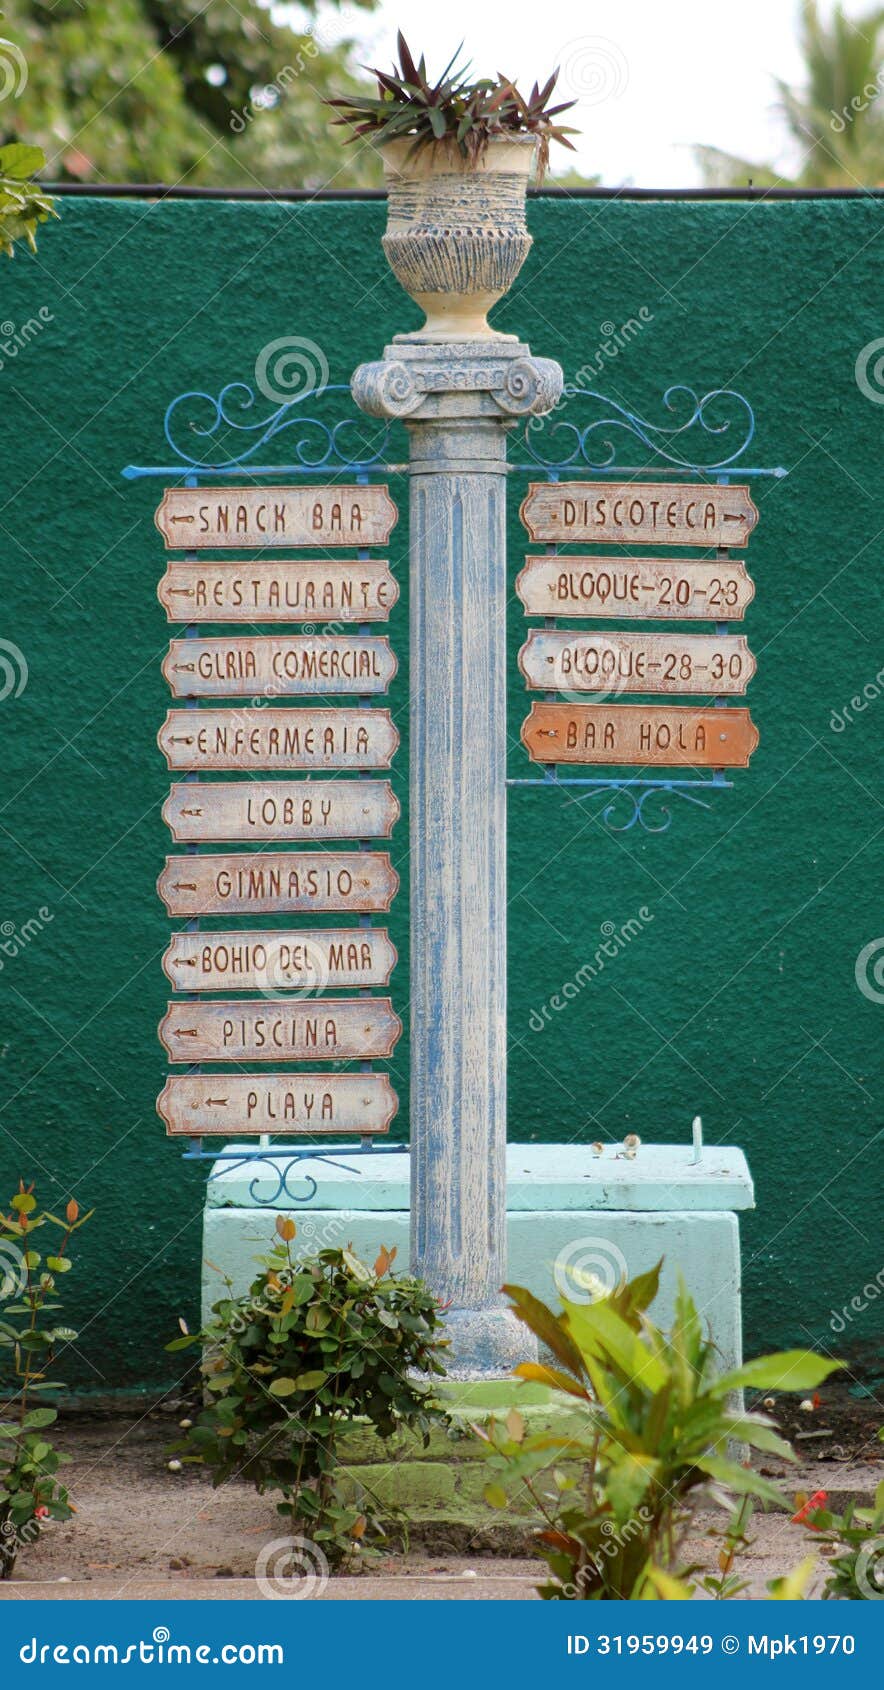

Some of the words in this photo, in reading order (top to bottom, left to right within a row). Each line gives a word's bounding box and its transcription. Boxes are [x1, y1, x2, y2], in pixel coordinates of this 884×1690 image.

[199, 505, 286, 533] SNACK
[563, 500, 716, 529] DISCOTECA
[196, 580, 387, 608] RESTAURANTE
[199, 652, 256, 680] GLRIA
[272, 650, 381, 679] COMERCIAL
[197, 727, 369, 755] ENFERMERIA
[566, 721, 615, 749] BAR
[640, 723, 706, 751] HOLA
[247, 798, 332, 826] LOBBY
[216, 869, 353, 898] GIMNASIO
[201, 944, 267, 974] BOHIO
[279, 944, 313, 971] DEL
[328, 943, 373, 971] MAR
[222, 1019, 337, 1048] PISCINA
[247, 1092, 333, 1121] PLAYA
